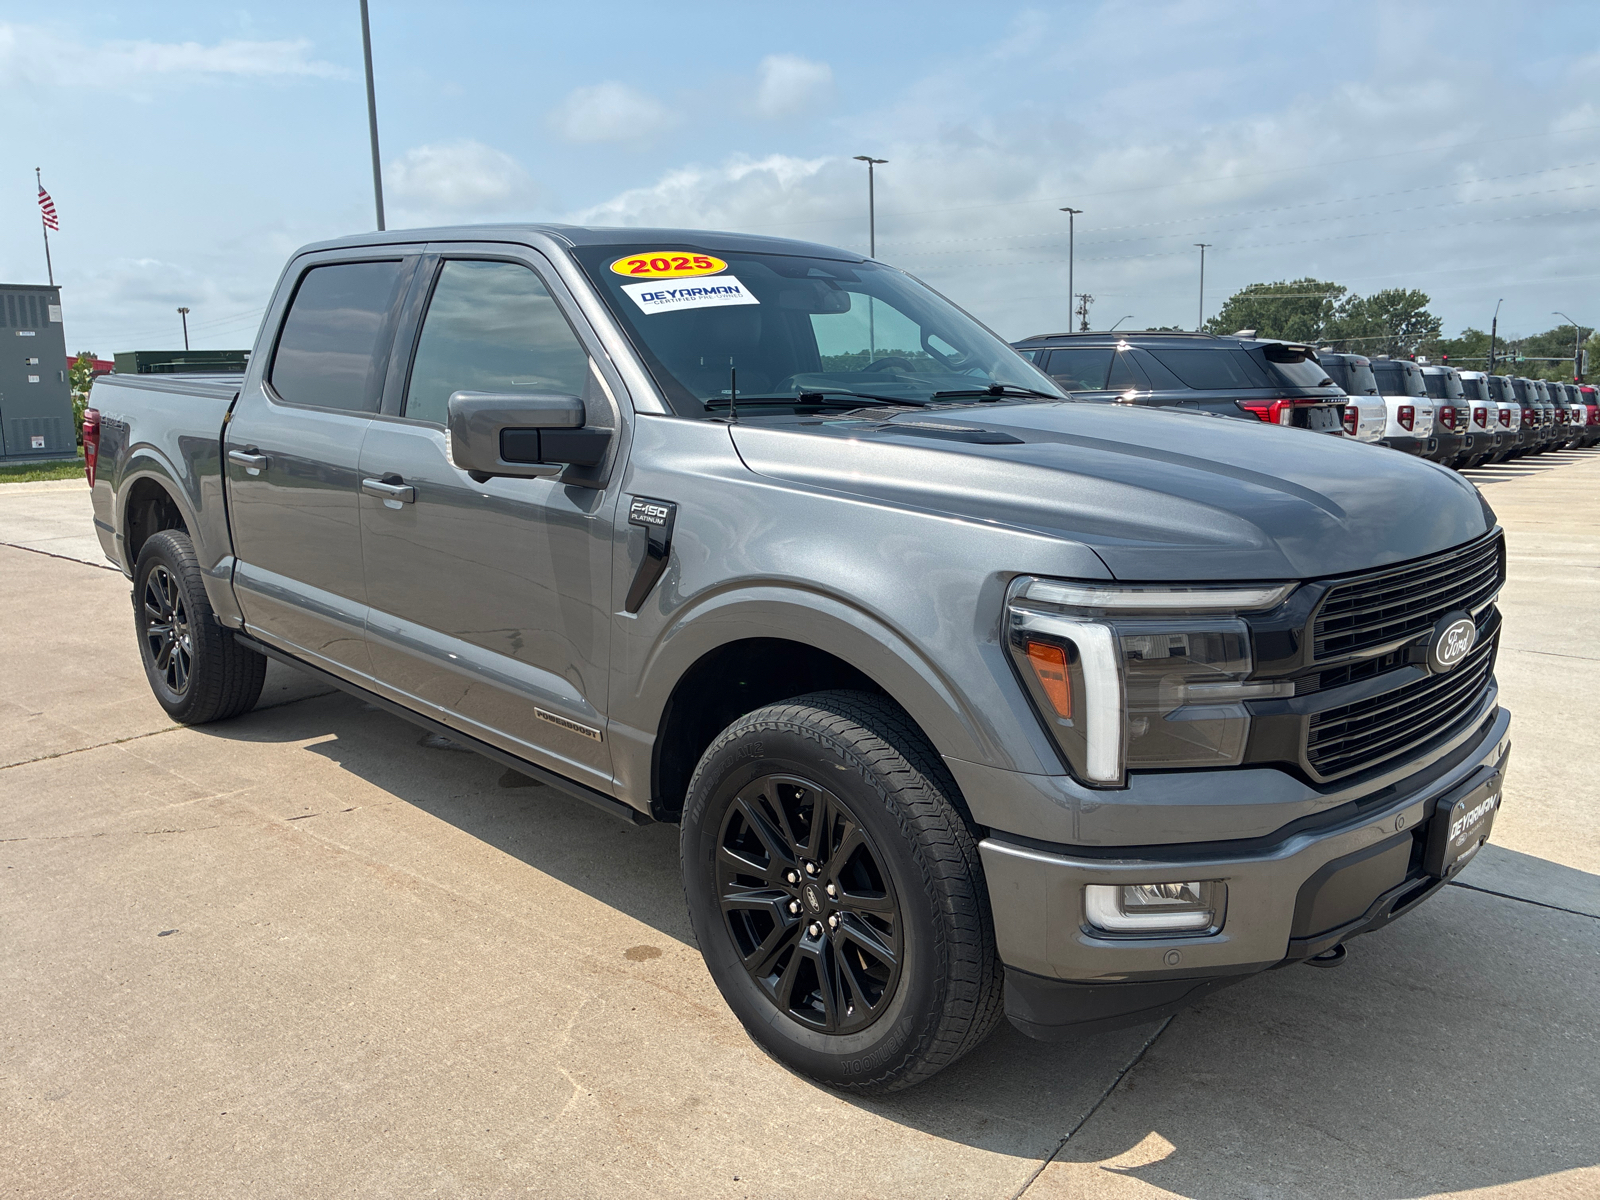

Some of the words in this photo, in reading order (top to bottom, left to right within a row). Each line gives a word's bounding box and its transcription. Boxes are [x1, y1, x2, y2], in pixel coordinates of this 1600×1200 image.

[627, 256, 714, 274] 2025
[641, 286, 741, 302] DEYARMAN
[654, 295, 697, 305] CERTIFIED
[698, 293, 744, 301] PRE-OWNED
[631, 502, 668, 518] F-150
[631, 513, 664, 525] PLATINUM
[1444, 626, 1470, 660] Ford
[537, 710, 597, 738] POWERBOOST
[1449, 793, 1498, 841] DEYARMAN
